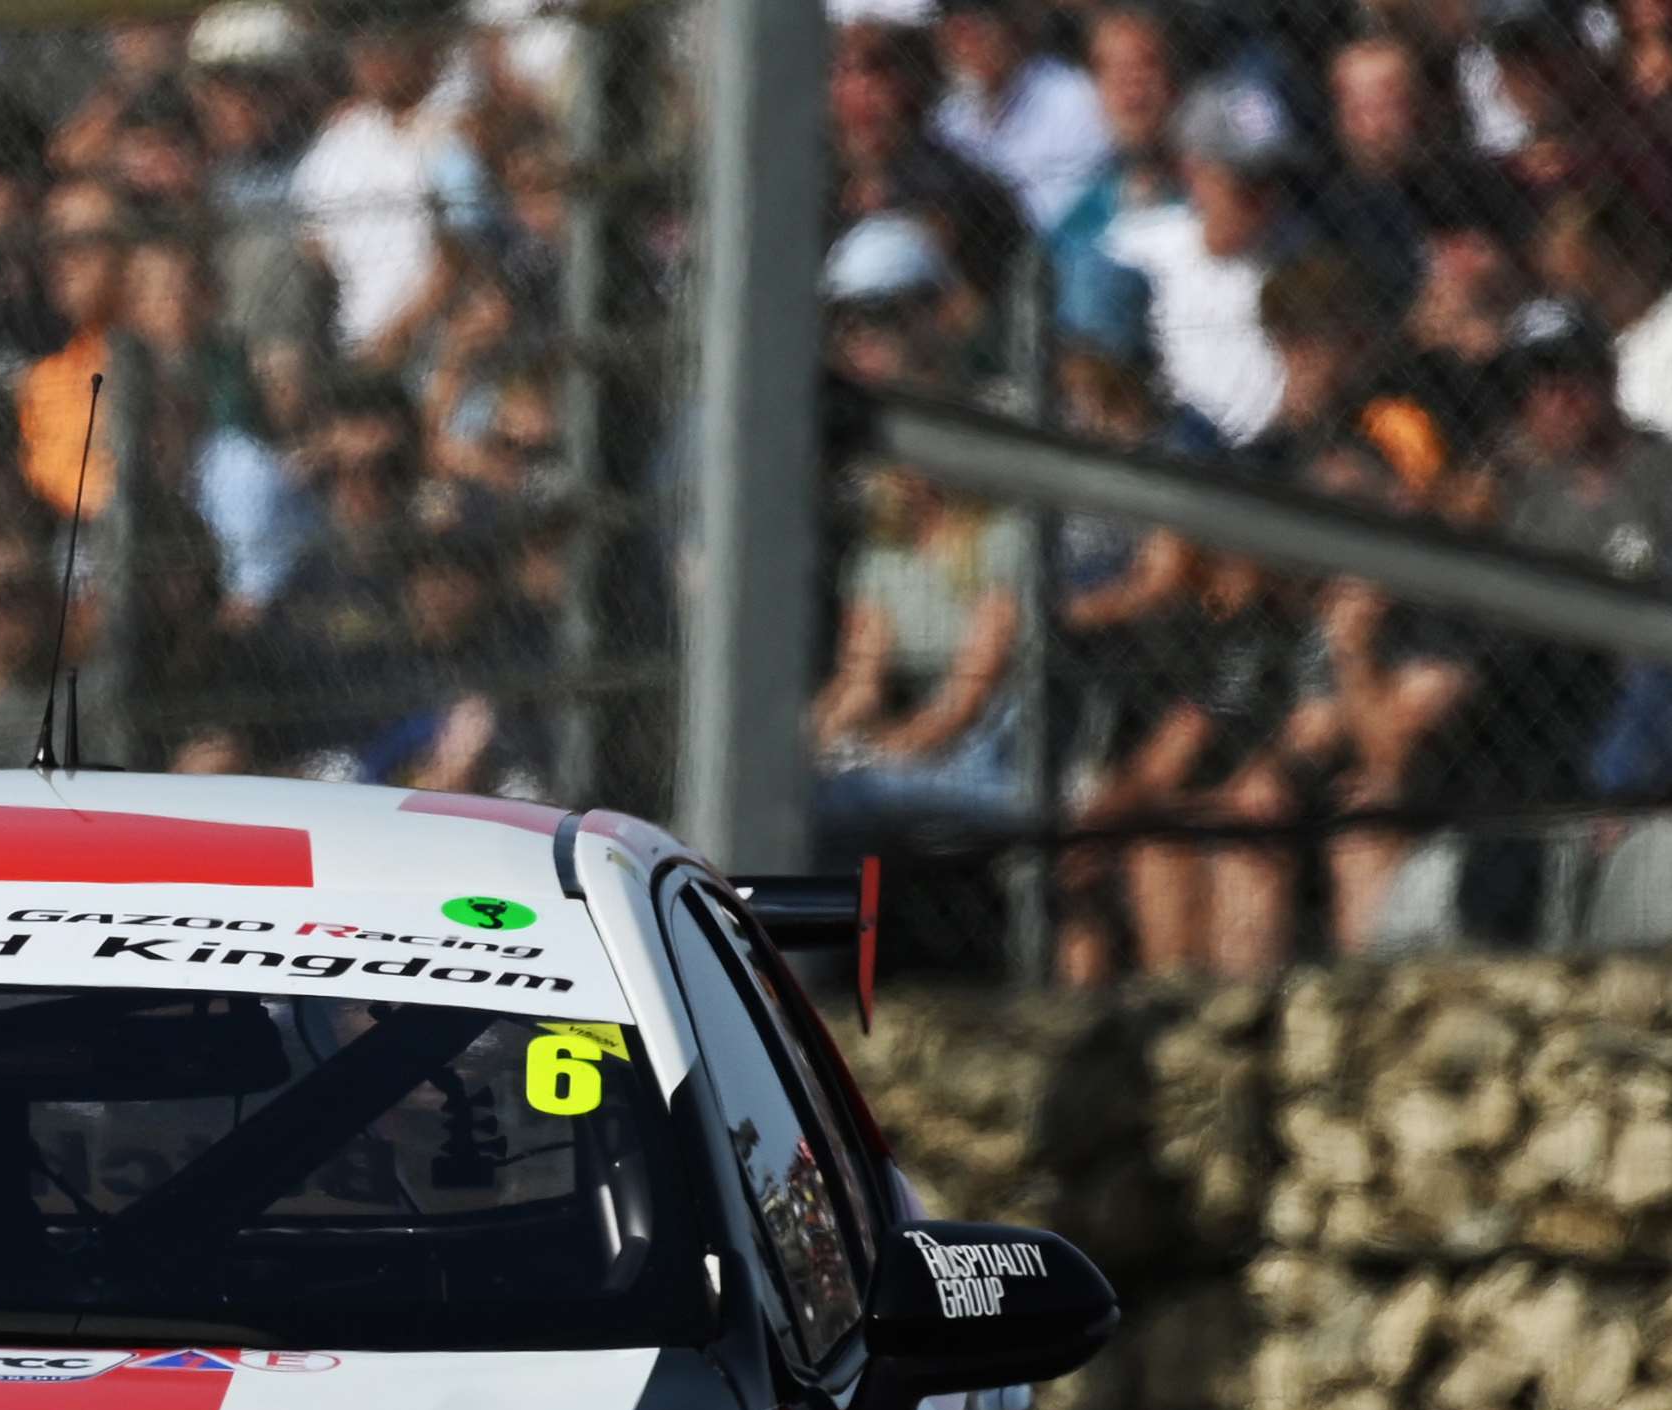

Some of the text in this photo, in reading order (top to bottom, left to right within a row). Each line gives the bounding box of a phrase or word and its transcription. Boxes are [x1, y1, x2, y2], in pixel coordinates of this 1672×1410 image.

[7, 909, 274, 935] GAZOO
[294, 922, 544, 962] Racing
[93, 936, 575, 994] Kingdom
[526, 1035, 602, 1116] 6
[919, 1243, 1048, 1279] HOSPITALITY
[935, 1276, 1005, 1319] GROUP
